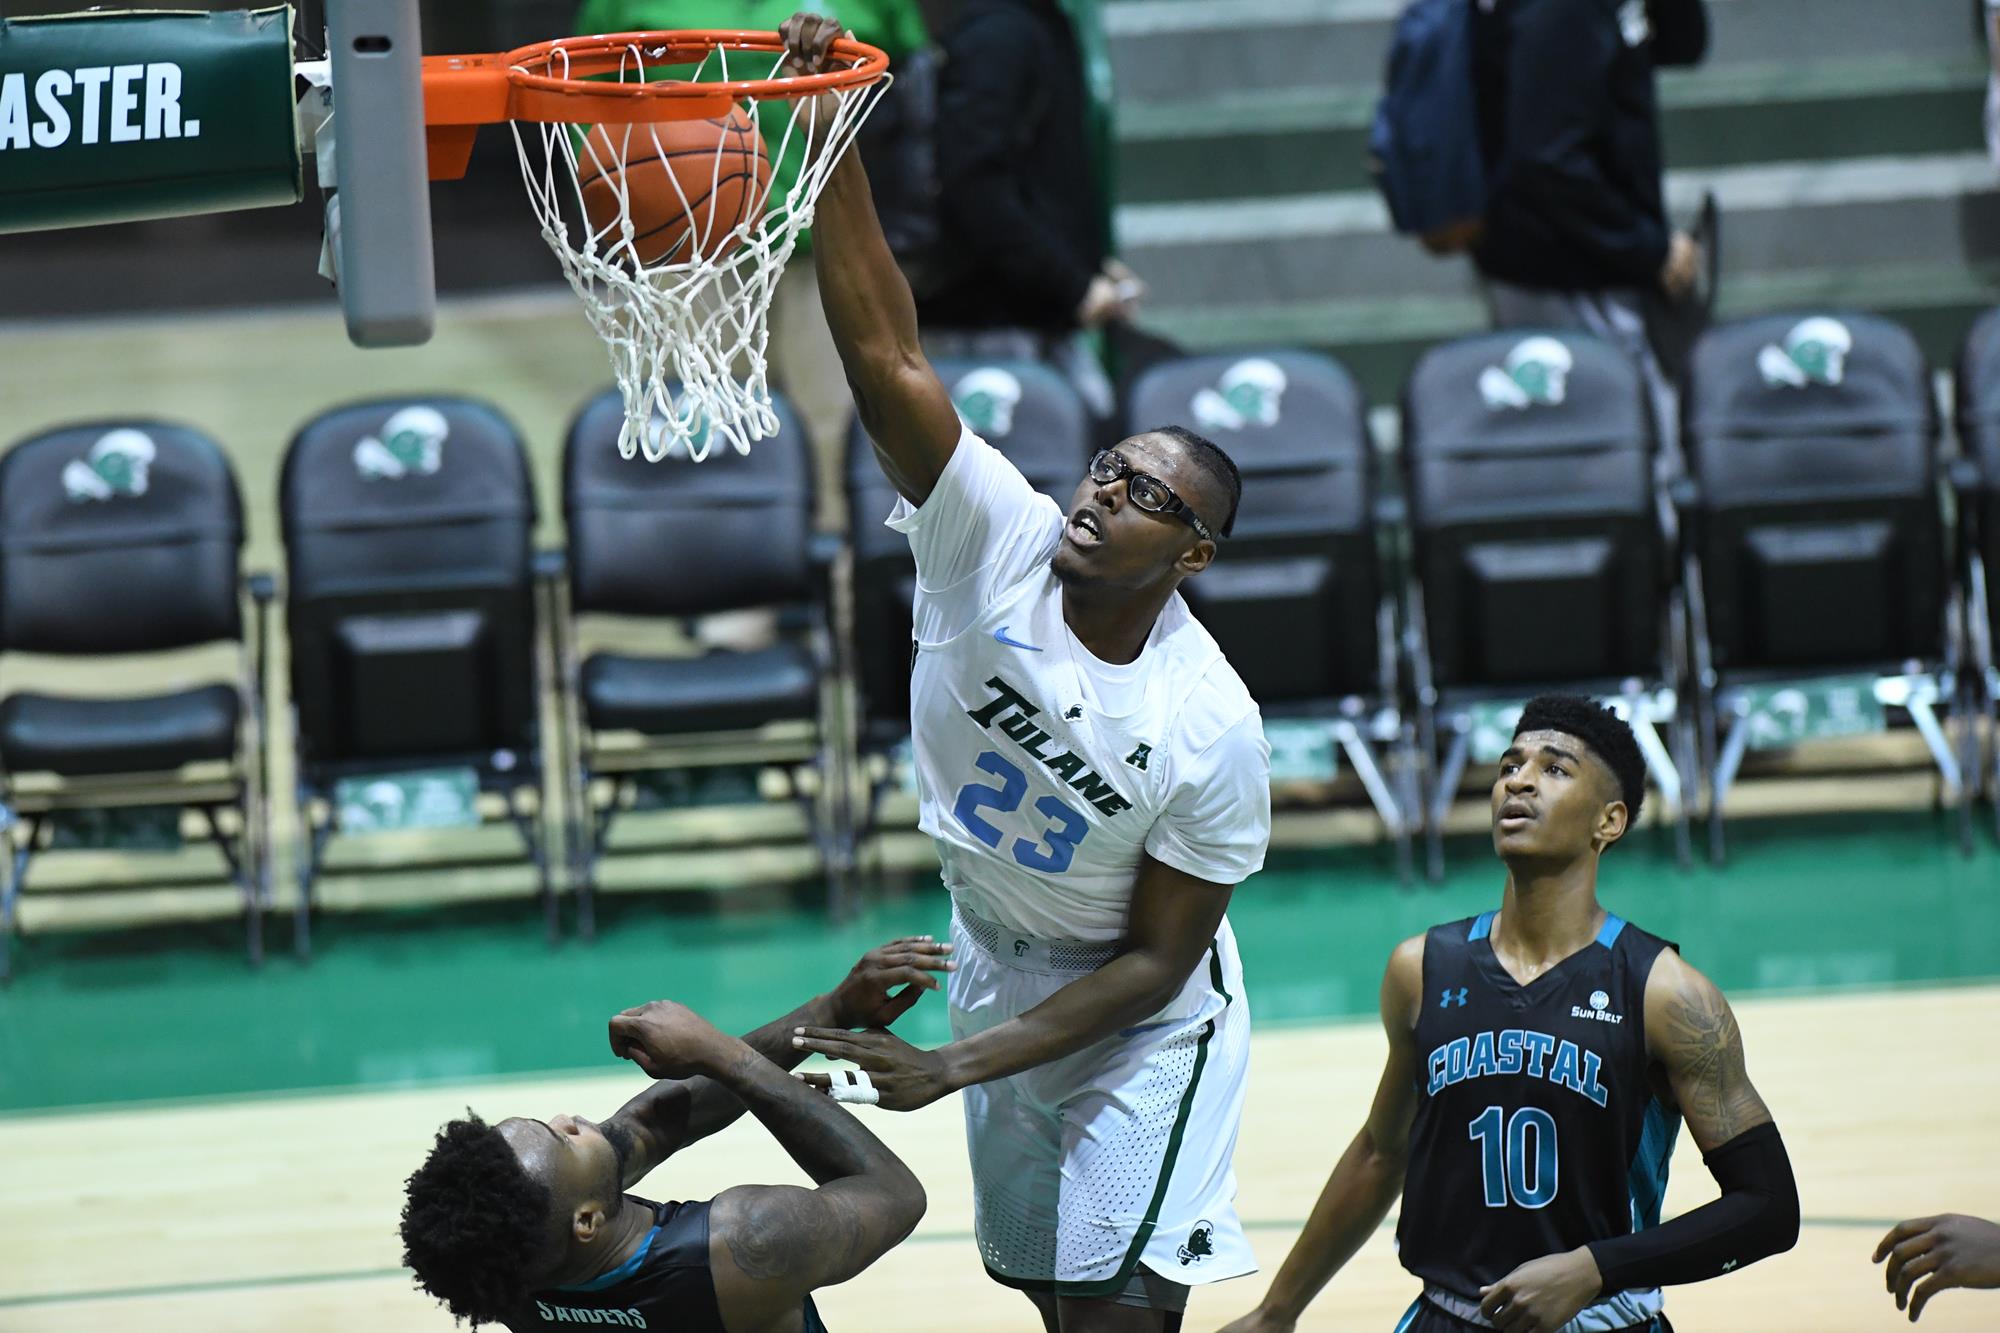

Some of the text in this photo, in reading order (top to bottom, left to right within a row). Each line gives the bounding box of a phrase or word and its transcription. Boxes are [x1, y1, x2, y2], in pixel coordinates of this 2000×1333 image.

[0, 62, 200, 149] ASTER.
[967, 676, 1133, 817] TULANE
[953, 751, 1090, 873] 23
[1571, 1005, 1623, 1024] SUN BELT
[1427, 1029, 1608, 1108] COASTAL
[1469, 1106, 1558, 1209] 10
[536, 1299, 647, 1330] SANDERS
